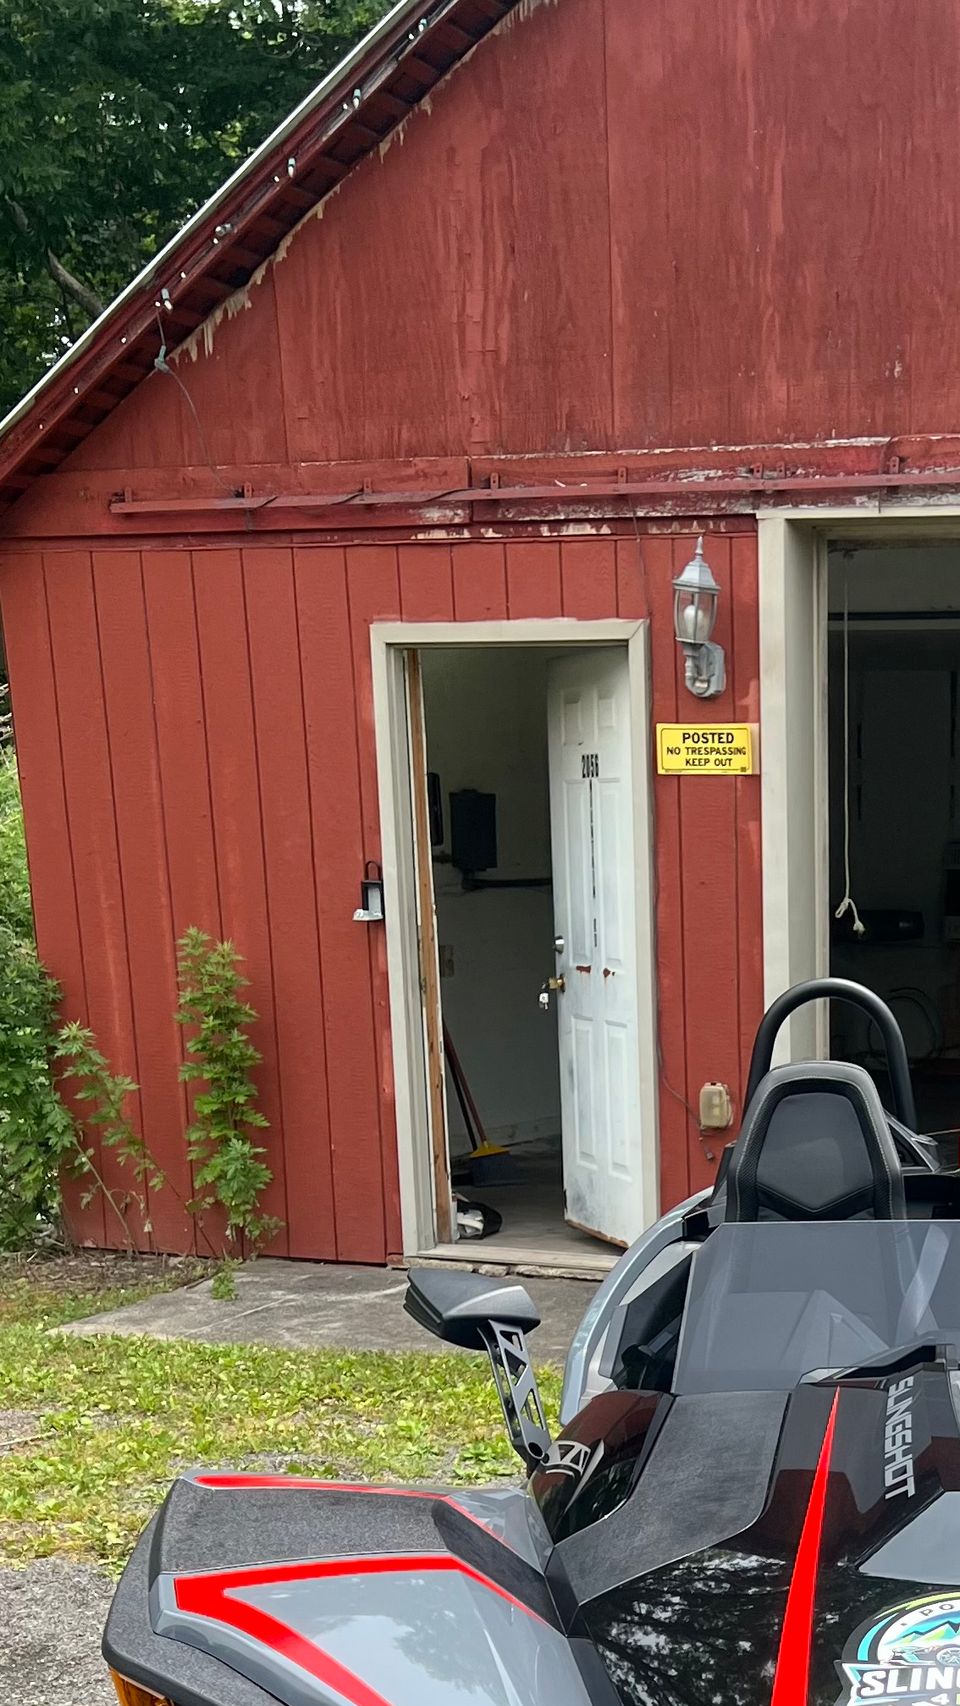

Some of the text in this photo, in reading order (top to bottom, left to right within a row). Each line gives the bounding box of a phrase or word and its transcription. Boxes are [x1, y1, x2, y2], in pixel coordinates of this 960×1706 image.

[682, 732, 734, 744] POSTED
[666, 746, 747, 755] NO TRESPASSING
[685, 758, 733, 767] KEEP OUT
[884, 1376, 916, 1500] SLINGSHOT
[930, 1693, 951, 1706] 4
